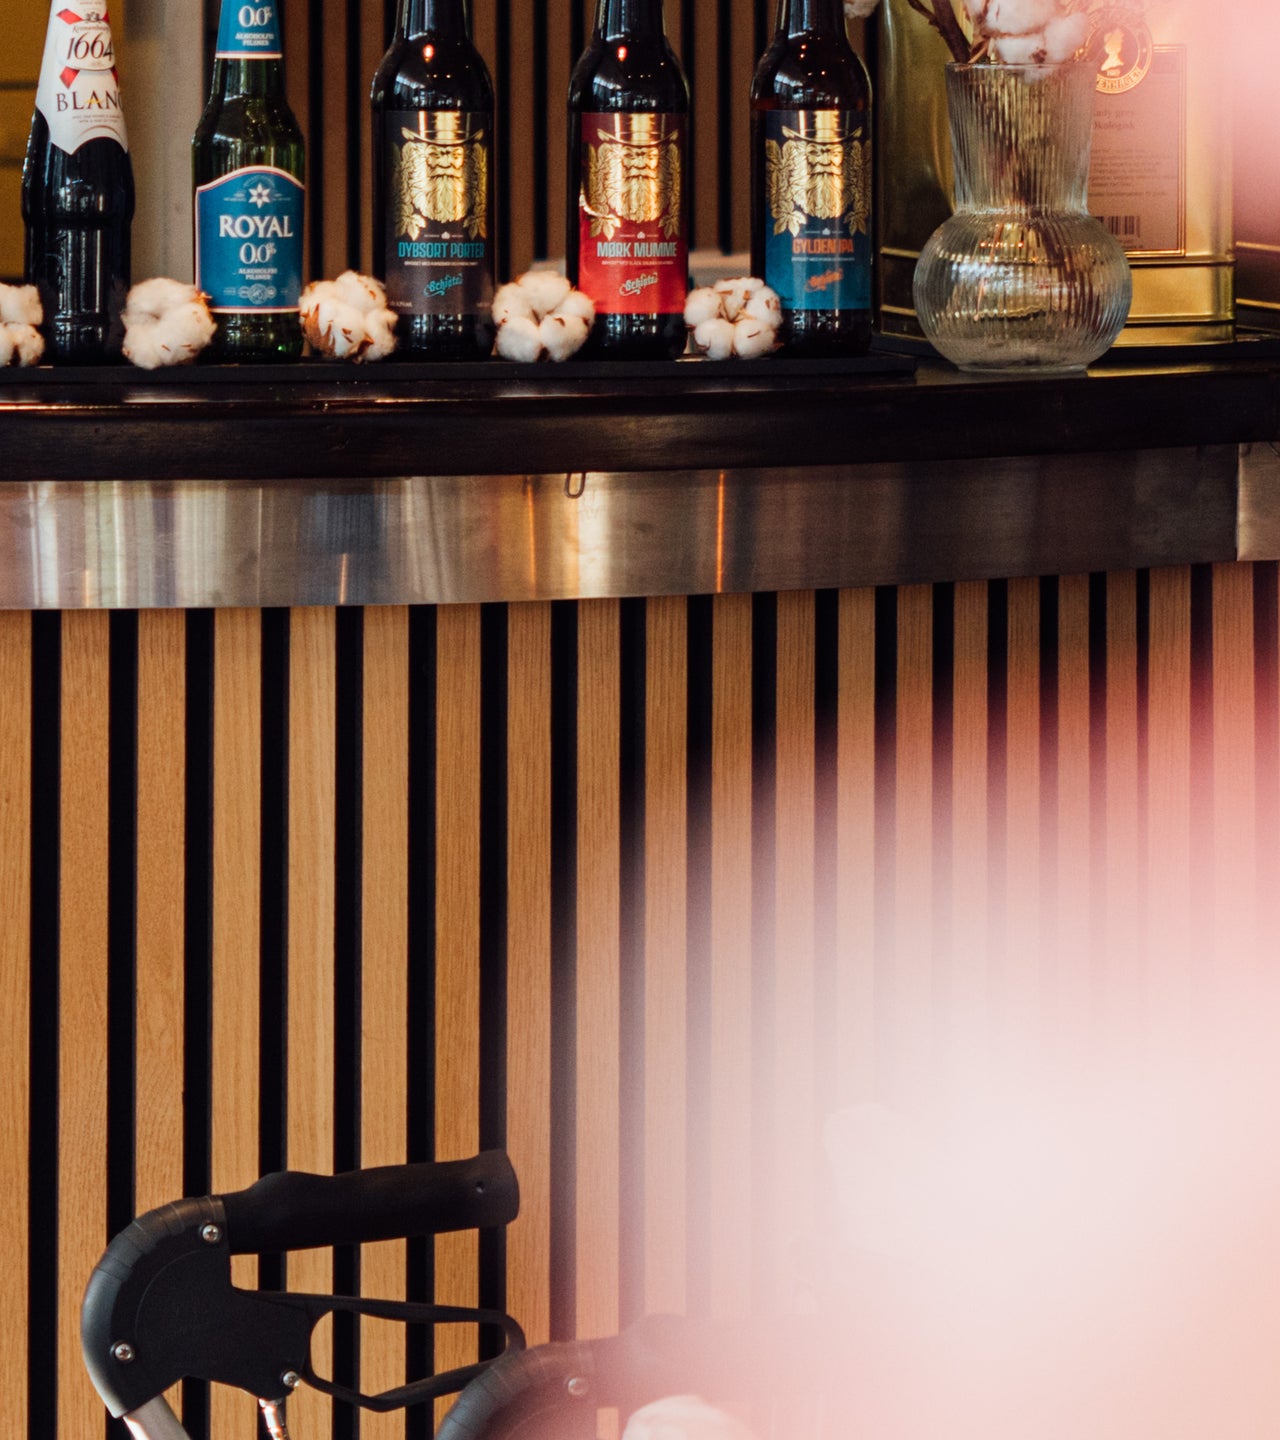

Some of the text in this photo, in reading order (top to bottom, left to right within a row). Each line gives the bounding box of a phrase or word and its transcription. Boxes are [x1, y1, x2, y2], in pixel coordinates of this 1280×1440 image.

[66, 32, 114, 61] 1664
[219, 215, 293, 238] ROYAL
[450, 242, 484, 258] PORTER
[597, 242, 677, 257] MØRK MUMME
[792, 238, 836, 254] GYLDEN
